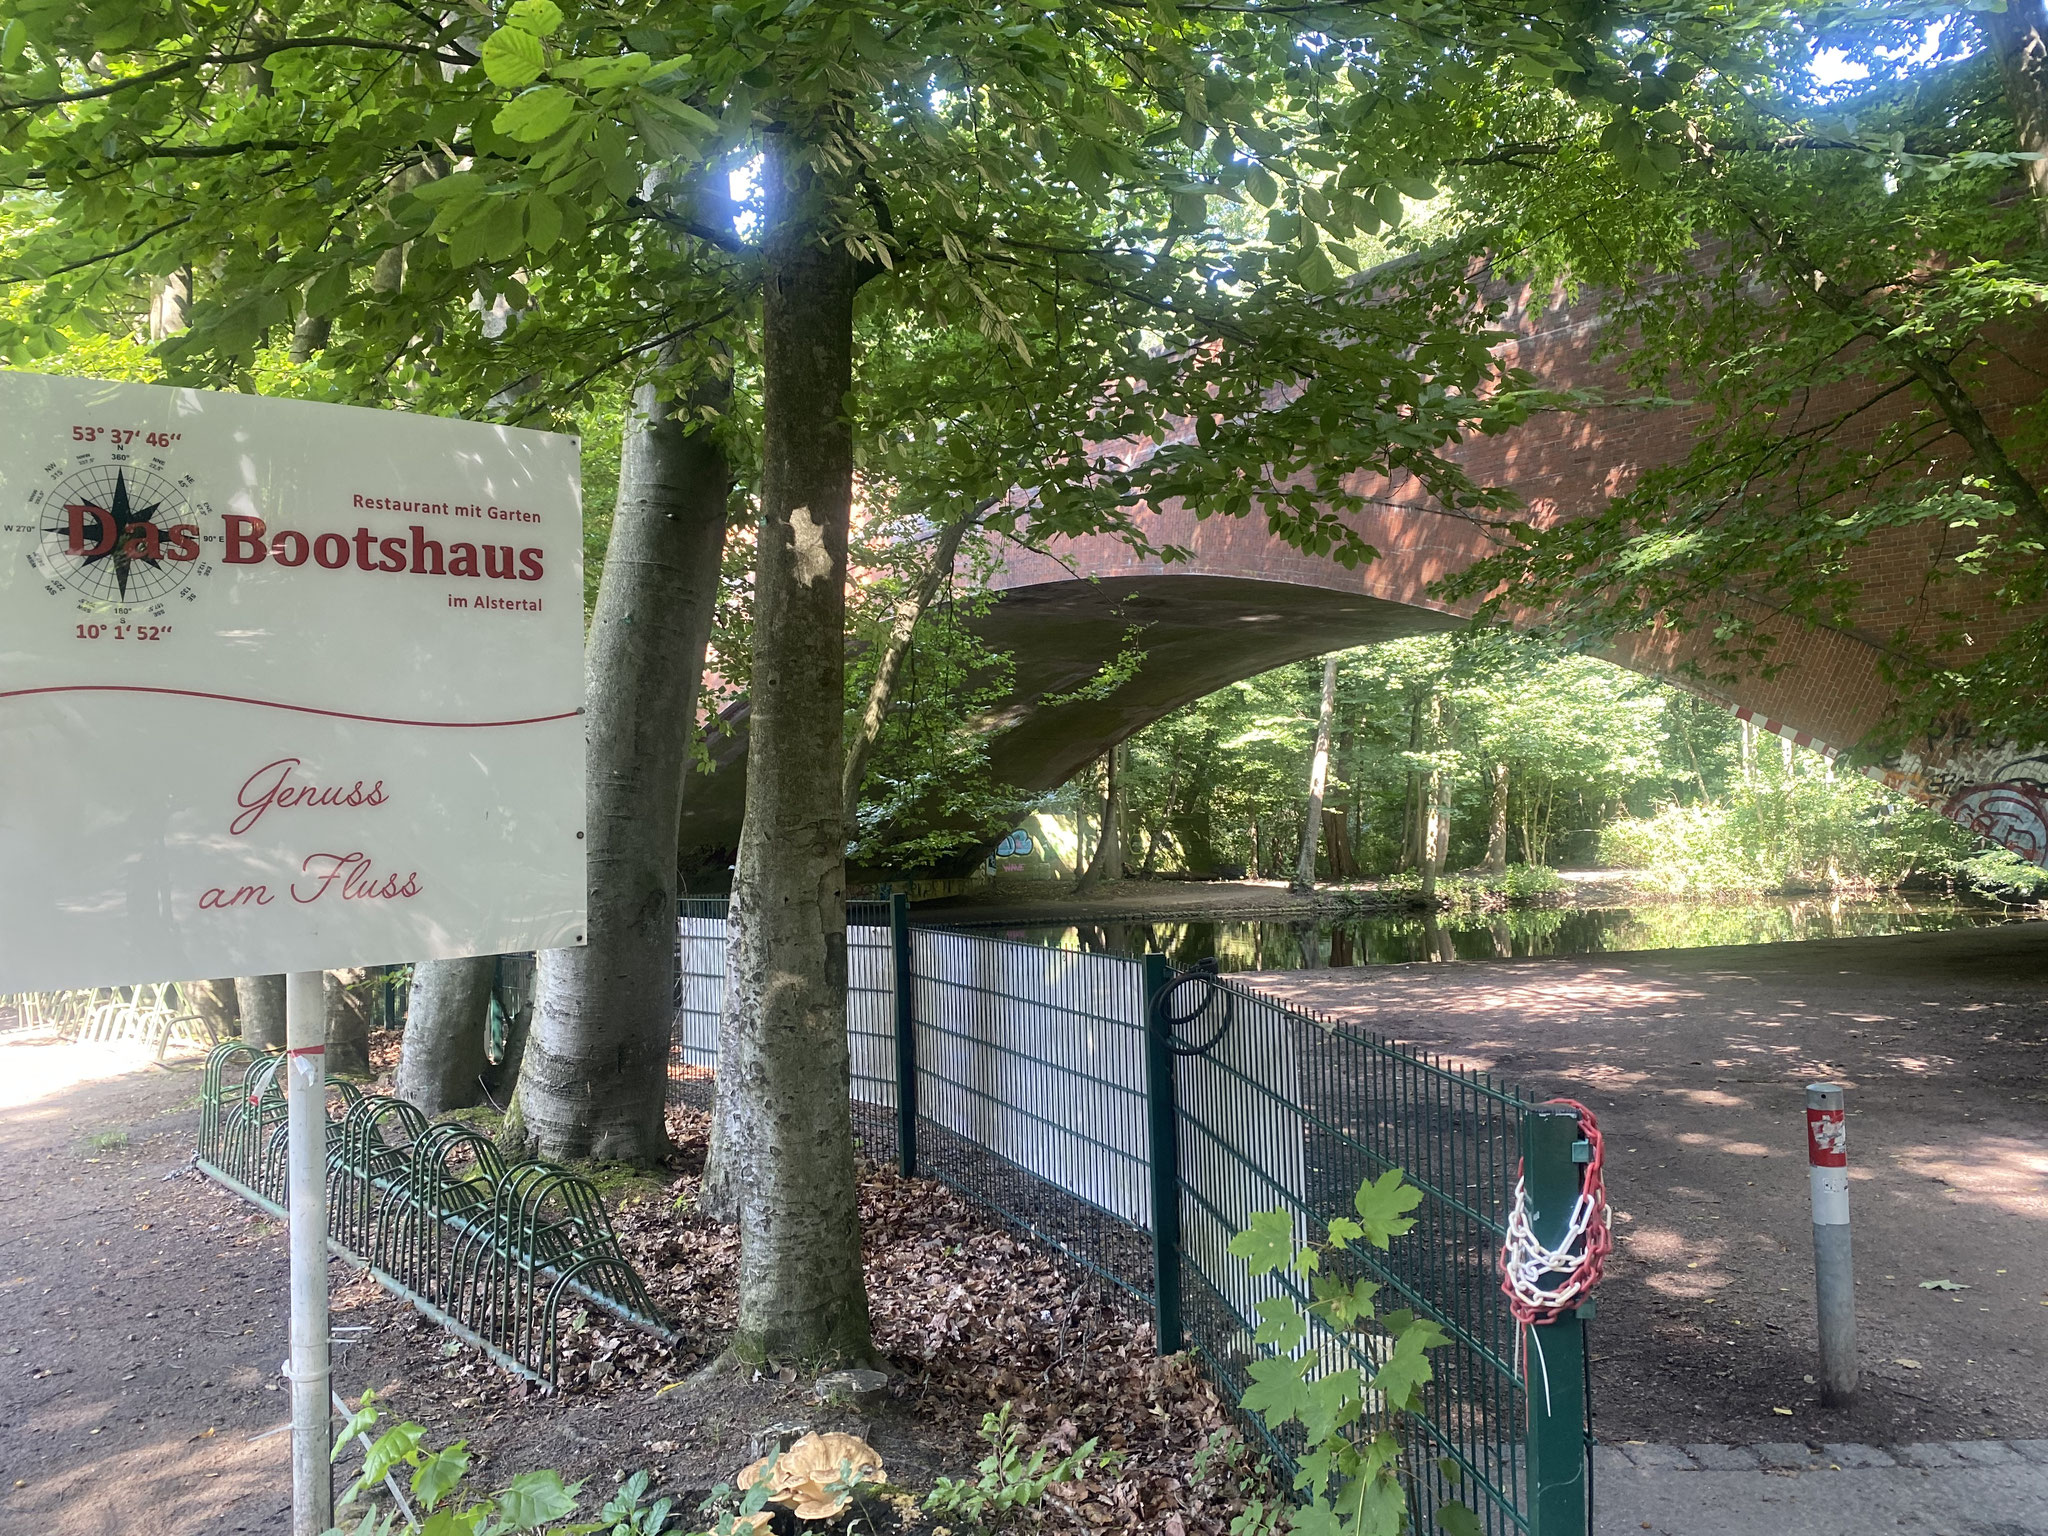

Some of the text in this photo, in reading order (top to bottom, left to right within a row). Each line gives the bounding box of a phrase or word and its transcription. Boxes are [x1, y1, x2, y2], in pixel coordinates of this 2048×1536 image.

[72, 425, 105, 442] 53°
[111, 453, 130, 461] 360°
[152, 457, 166, 466] NNE
[44, 461, 57, 473] NW
[184, 474, 195, 485] NE
[353, 494, 541, 523] Restaurant mit Garten
[16, 525, 36, 533] 270°
[64, 504, 545, 581] Das Bootshaus
[203, 535, 225, 543] 90° E
[45, 585, 57, 596] SW
[186, 593, 197, 602] SE
[448, 594, 542, 611] im Alstertal
[76, 624, 107, 639] 10°
[230, 758, 389, 835] Genuss
[199, 852, 423, 909] am Fluss
